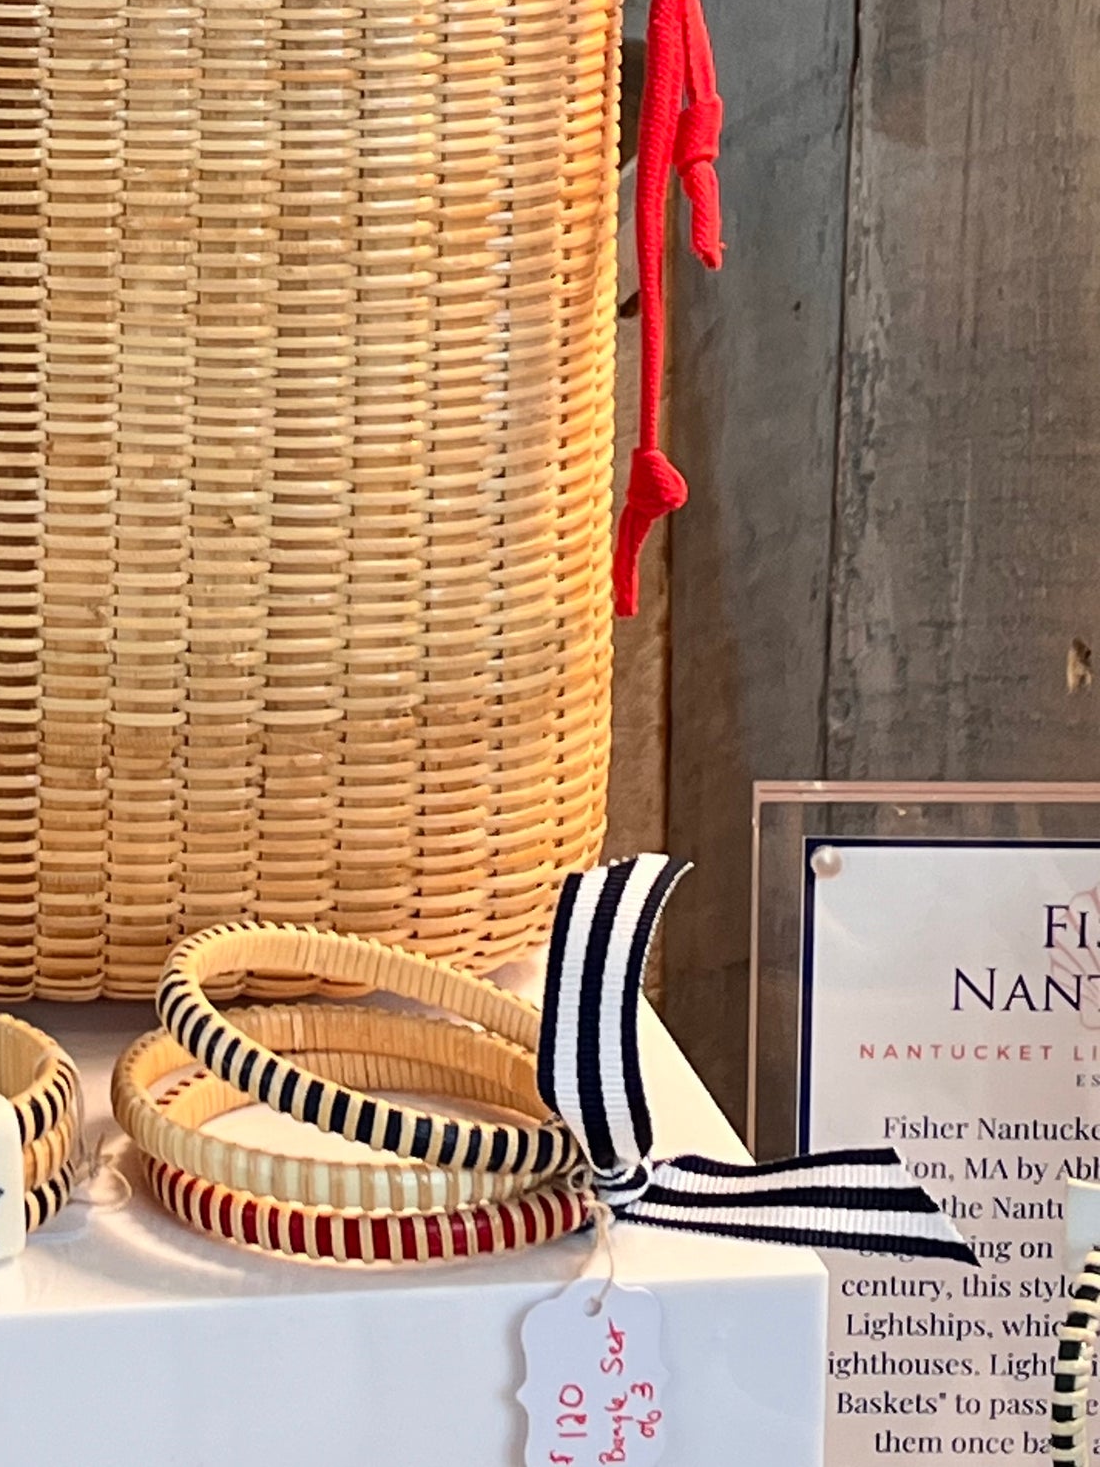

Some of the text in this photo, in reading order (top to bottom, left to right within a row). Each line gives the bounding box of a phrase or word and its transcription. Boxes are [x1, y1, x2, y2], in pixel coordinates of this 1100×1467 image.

[1043, 904, 1100, 948] FI
[860, 1044, 1097, 1062] NANTUCKET LI
[883, 1116, 969, 1140] Fisher
[904, 1157, 954, 1182] on,
[964, 1156, 1008, 1180] MA
[1017, 1156, 1048, 1185] by
[941, 1195, 983, 1220] the
[1019, 1241, 1052, 1259] on
[841, 1276, 953, 1302] century,
[962, 1274, 1011, 1298] this
[846, 1312, 1066, 1342] Lightships, whic
[828, 1350, 981, 1381] ighthouses.
[956, 1392, 981, 1415] to
[989, 1397, 1048, 1420] pass
[874, 1430, 943, 1454] them
[951, 1435, 1015, 1455] once
